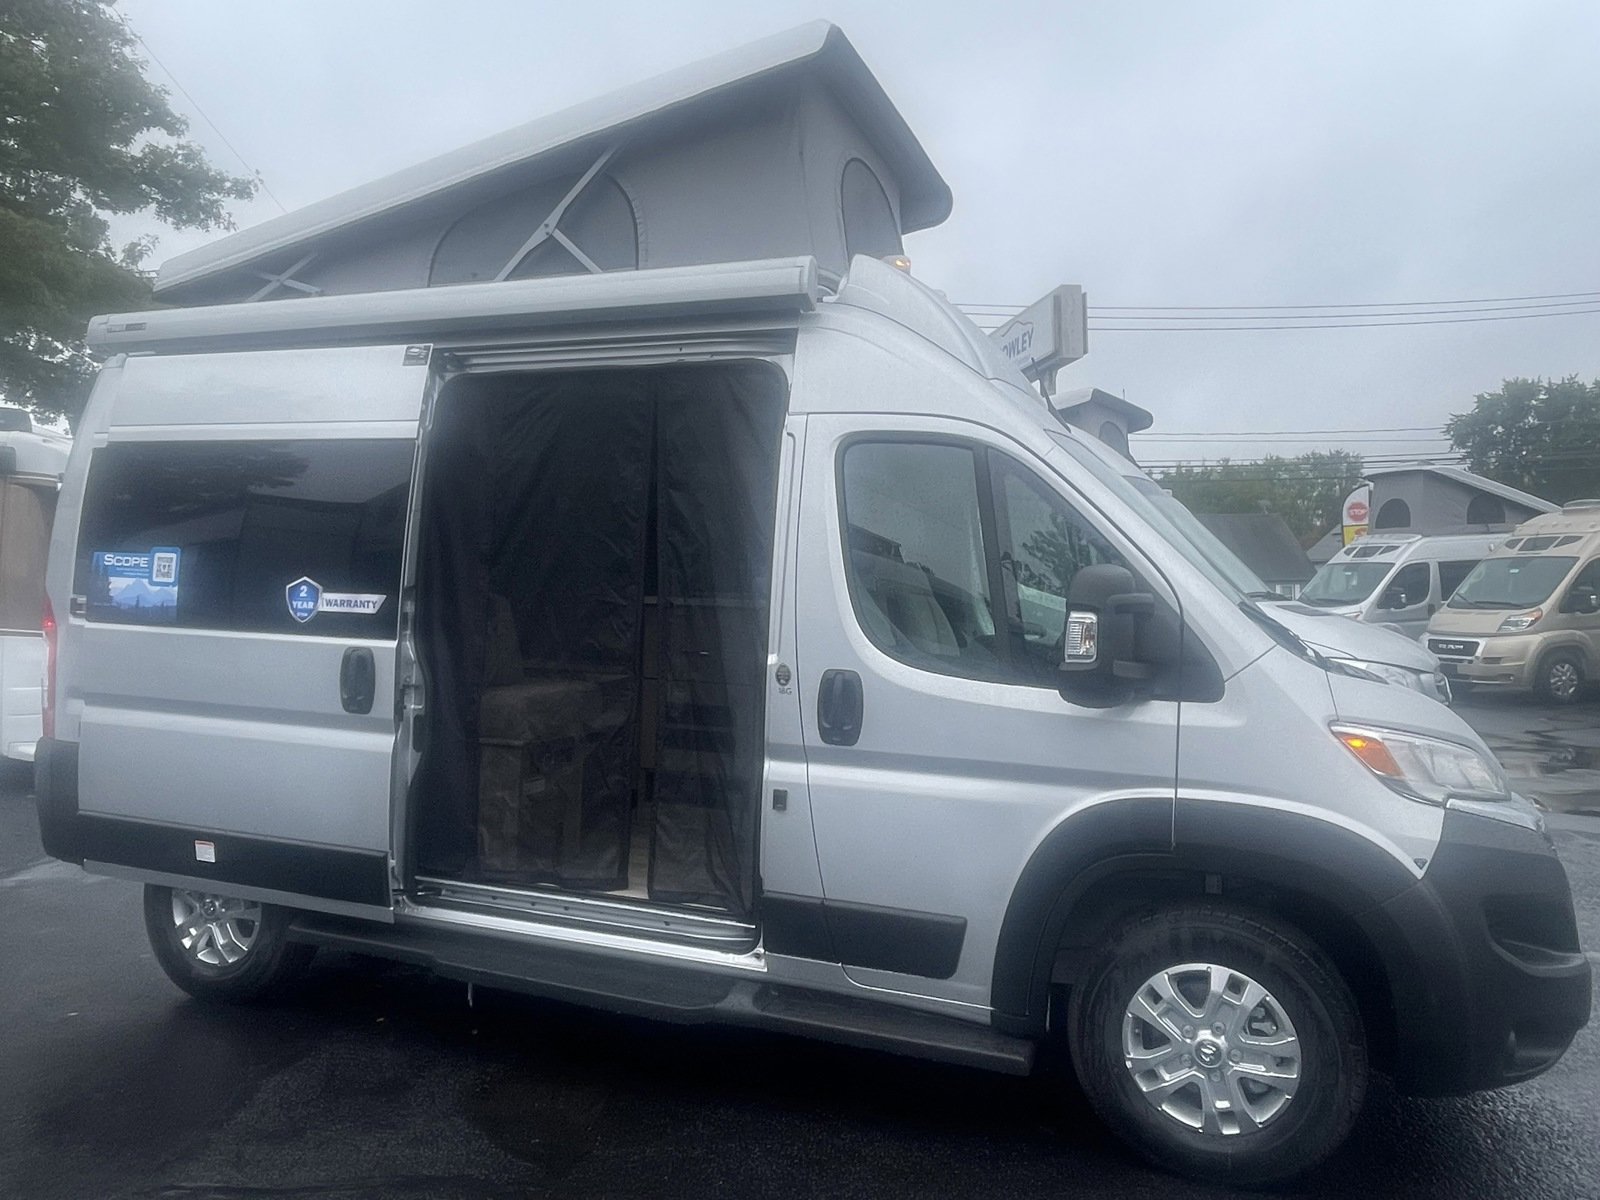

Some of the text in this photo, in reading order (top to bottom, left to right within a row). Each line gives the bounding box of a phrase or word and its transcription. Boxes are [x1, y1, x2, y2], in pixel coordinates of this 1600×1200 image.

[299, 585, 308, 597] 2
[292, 600, 314, 609] YEAR
[325, 598, 378, 609] WARRANTY
